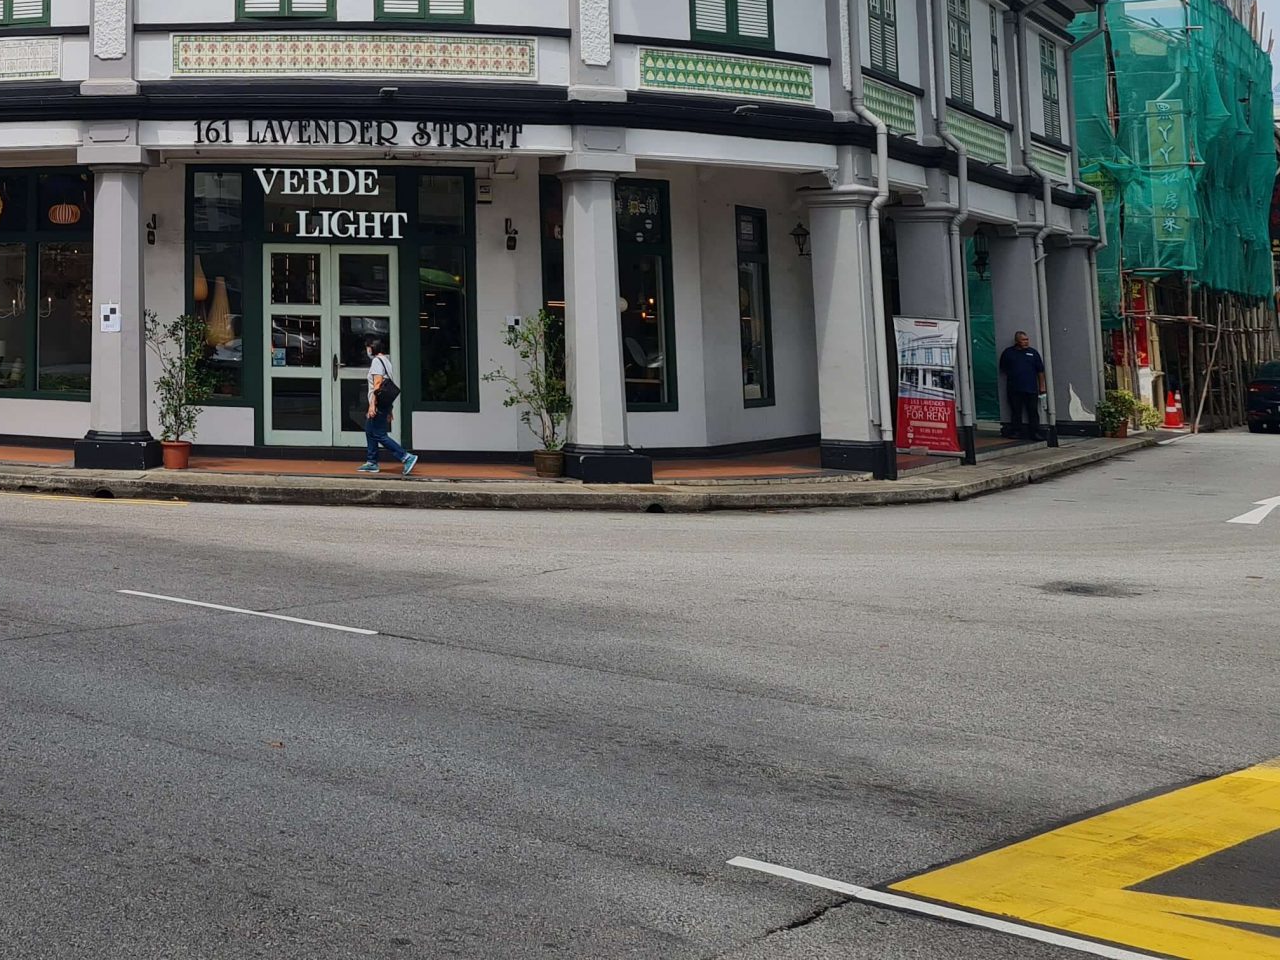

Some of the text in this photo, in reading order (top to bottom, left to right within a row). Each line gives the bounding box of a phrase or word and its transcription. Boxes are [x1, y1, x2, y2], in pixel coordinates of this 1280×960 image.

[193, 119, 523, 149] 161 LAVENDER STREET
[253, 168, 379, 195] VERDE
[295, 210, 408, 239] LIGHT
[906, 410, 950, 422] FOR RENT
